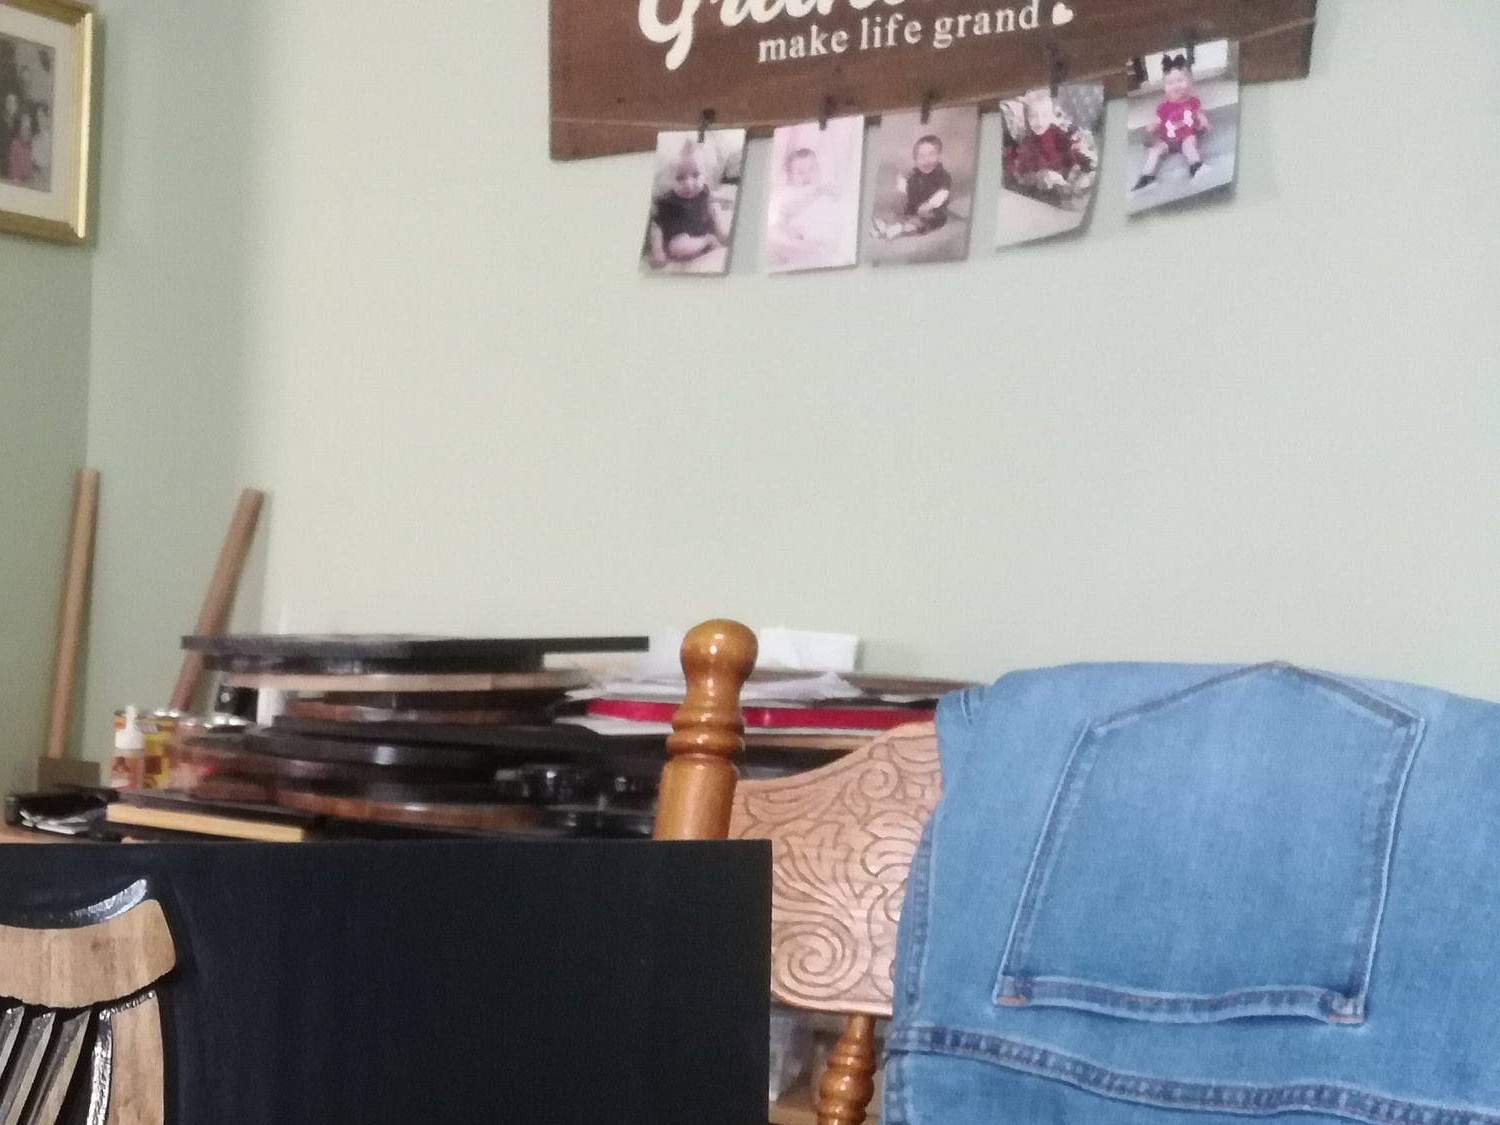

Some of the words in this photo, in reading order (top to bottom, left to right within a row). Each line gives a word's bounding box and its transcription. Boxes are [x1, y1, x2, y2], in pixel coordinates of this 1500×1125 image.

[757, 24, 849, 63] make
[859, 13, 922, 51] life
[932, 2, 1039, 49] grand
